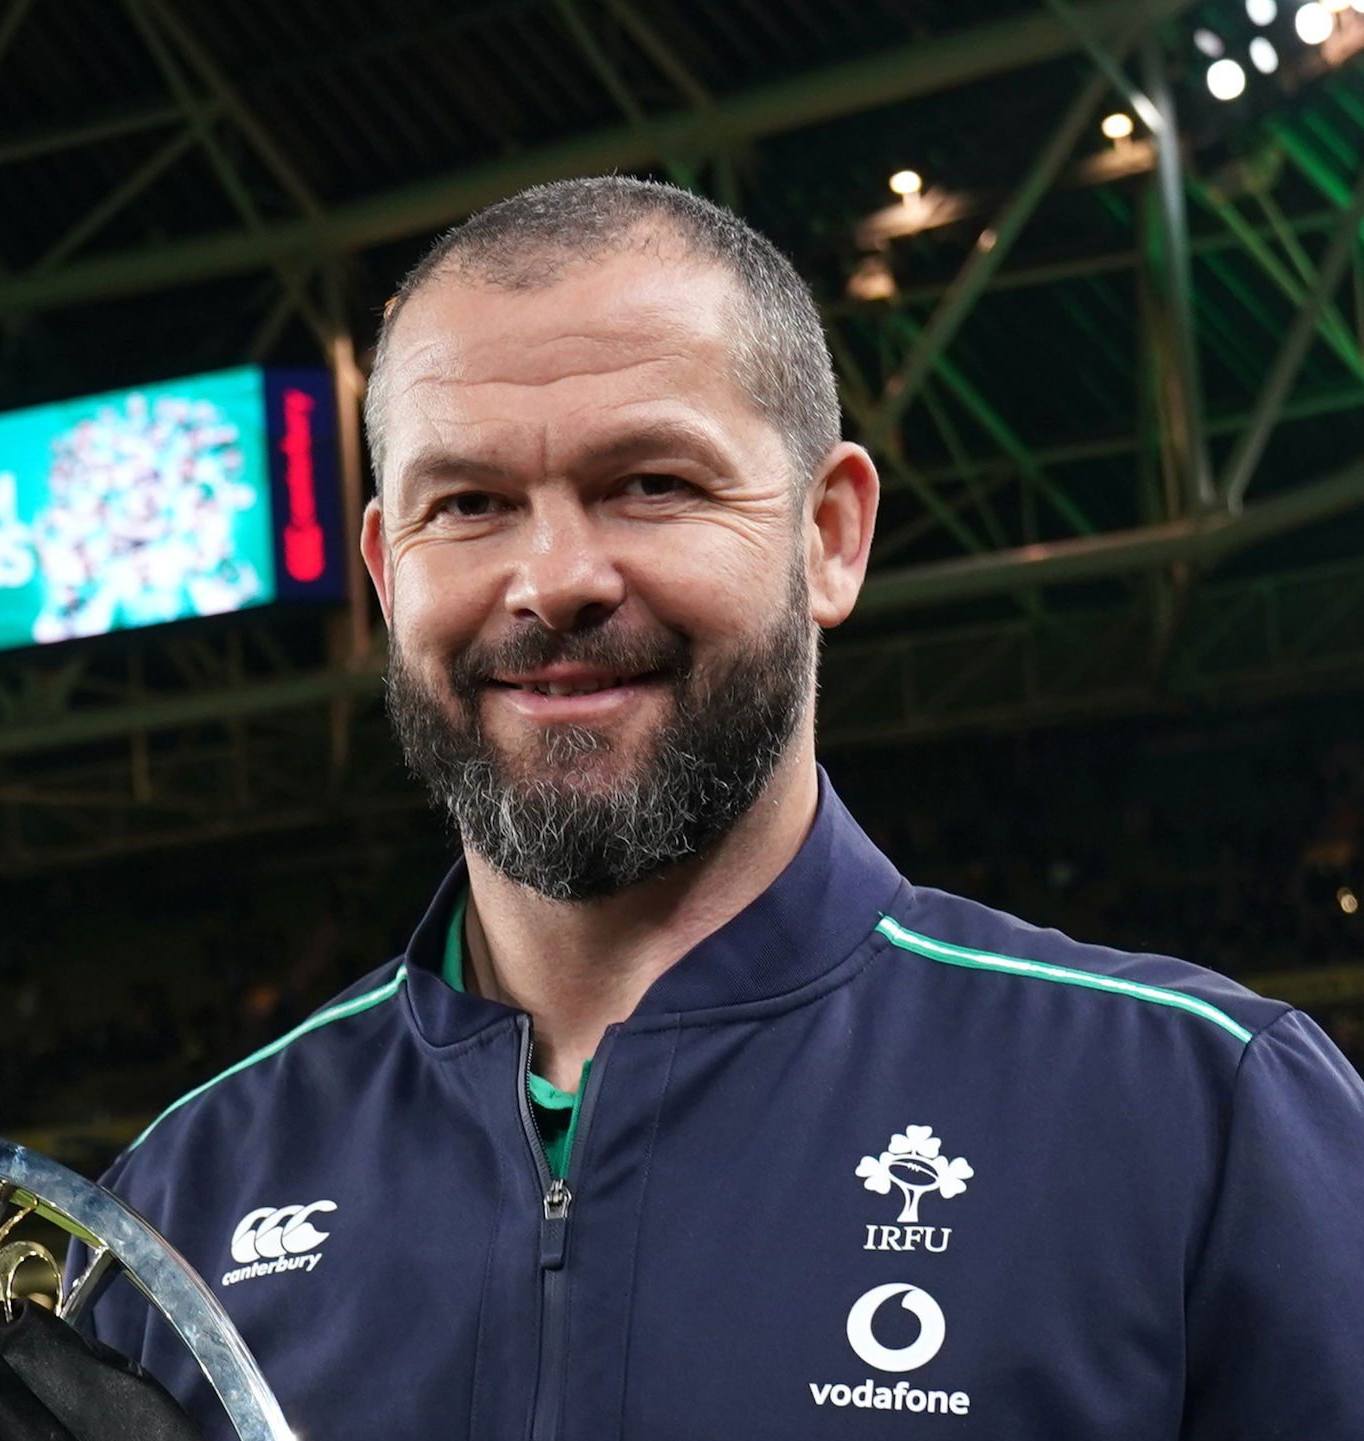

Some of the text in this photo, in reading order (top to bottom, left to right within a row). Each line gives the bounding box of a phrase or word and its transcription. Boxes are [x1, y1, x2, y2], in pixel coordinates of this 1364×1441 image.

[862, 1224, 953, 1253] IRFU
[221, 1253, 323, 1287] canterbury
[808, 1379, 971, 1416] vodafone
